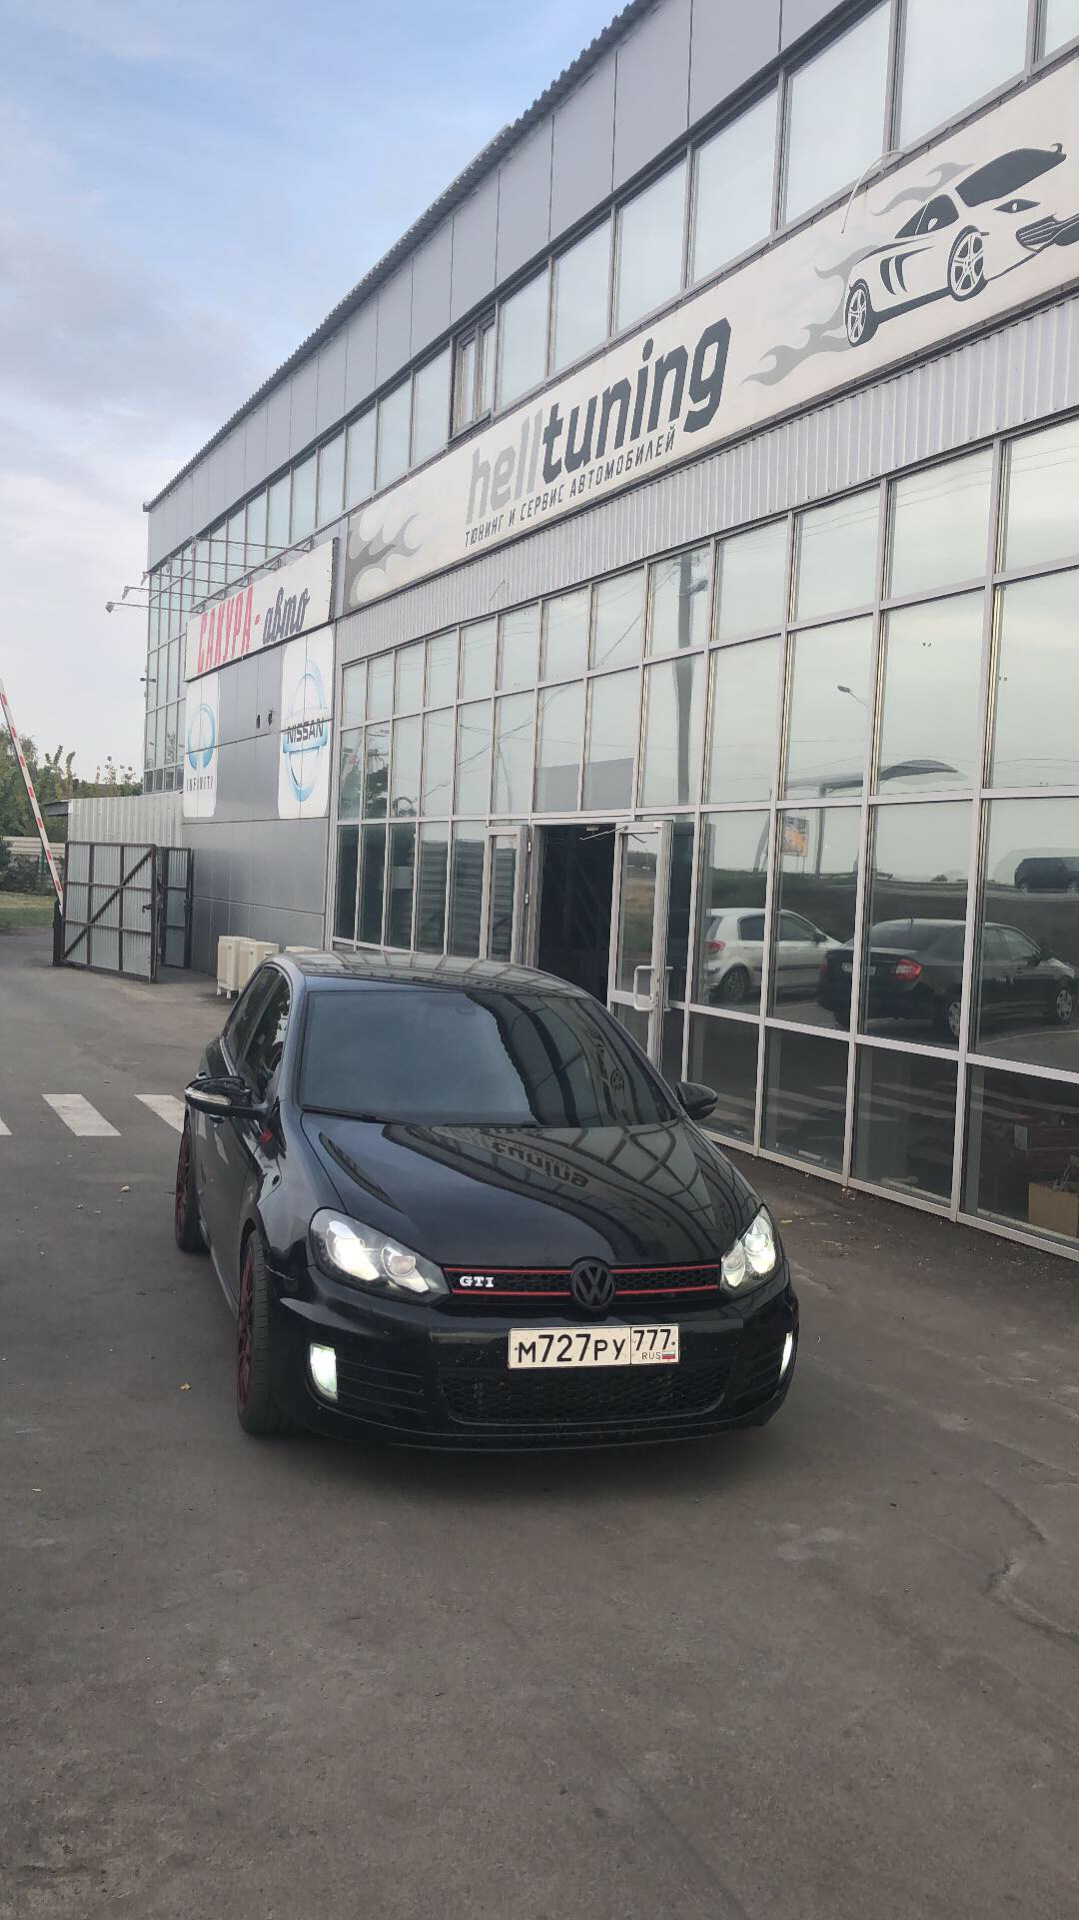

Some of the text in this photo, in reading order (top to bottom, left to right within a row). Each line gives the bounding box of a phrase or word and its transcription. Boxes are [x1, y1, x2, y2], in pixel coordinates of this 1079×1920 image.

[465, 425, 676, 546] ТЮНИНГ И СЕРВИС АВТОМОБИЛЕЙ
[286, 717, 325, 745] NISSAN
[459, 1275, 495, 1288] GTI
[632, 1328, 672, 1351] 777
[641, 1351, 661, 1360] RUS
